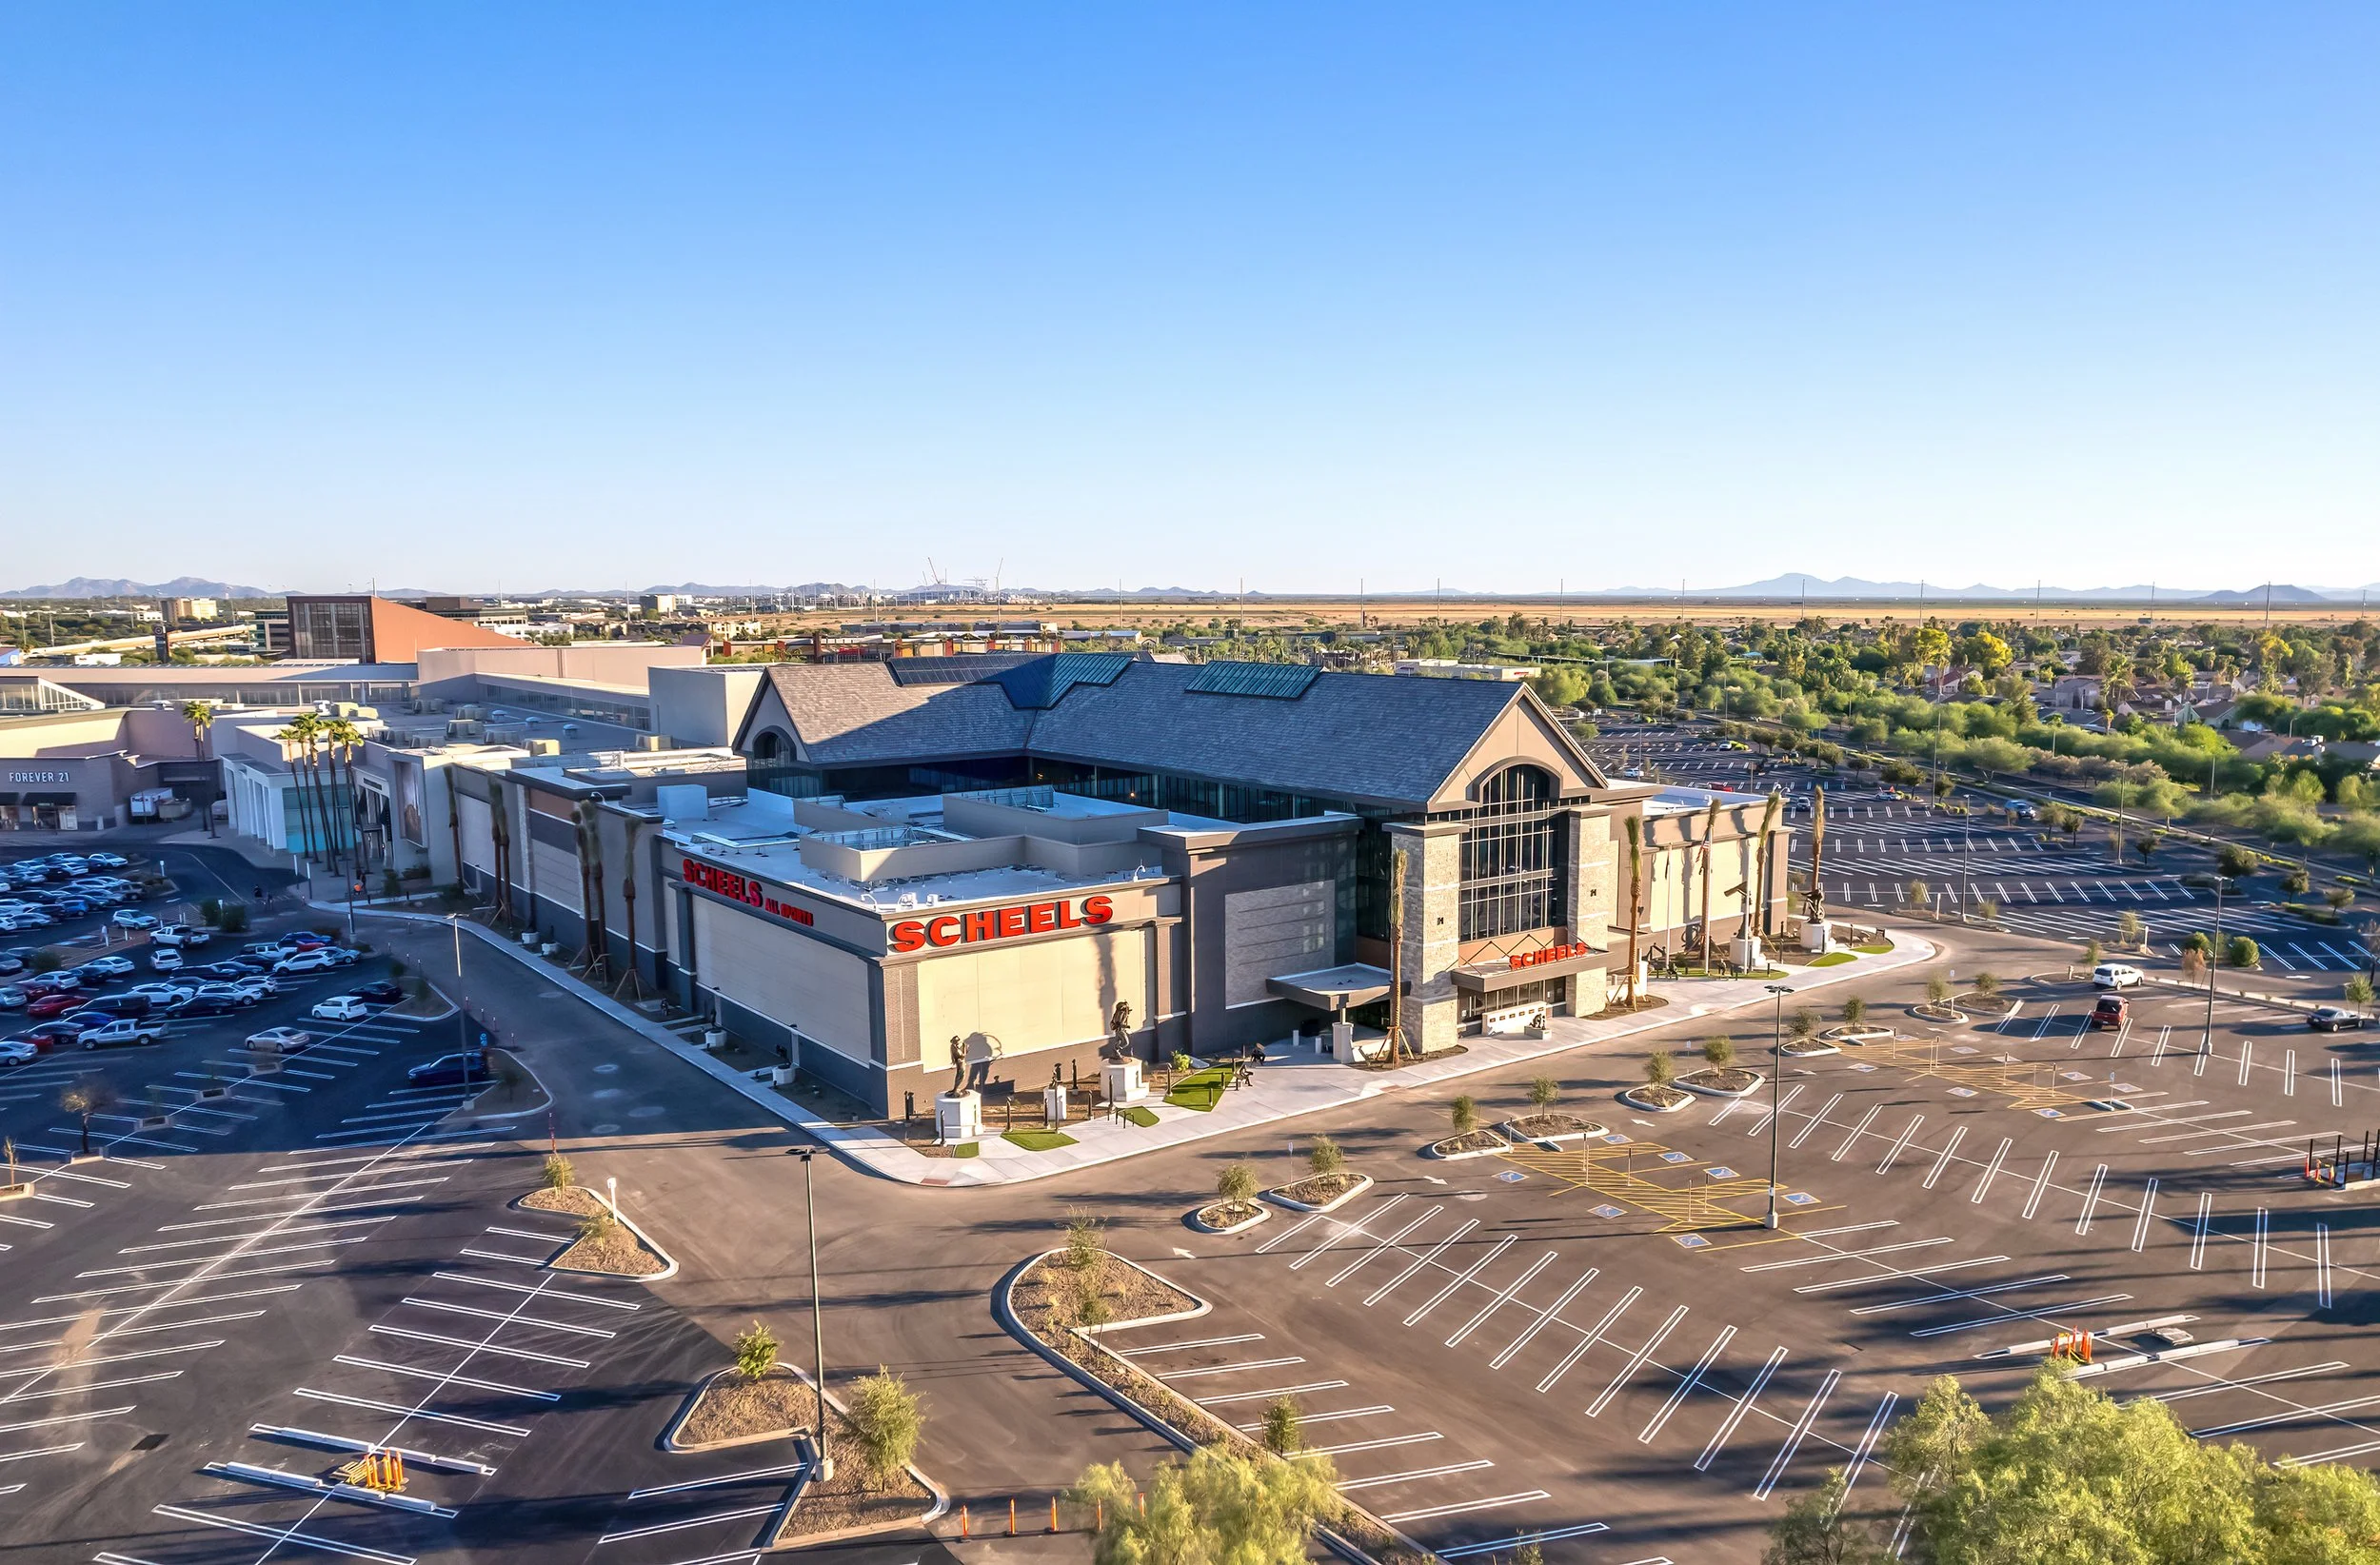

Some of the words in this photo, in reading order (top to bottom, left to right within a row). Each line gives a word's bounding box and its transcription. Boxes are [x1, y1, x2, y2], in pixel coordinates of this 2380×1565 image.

[9, 772, 54, 782] FOREVER
[58, 772, 69, 782] 21
[683, 859, 763, 907] SCHEELS
[765, 898, 780, 915] ALL
[889, 896, 1113, 952] SCHEELS
[1510, 942, 1587, 970] SCHEELS
